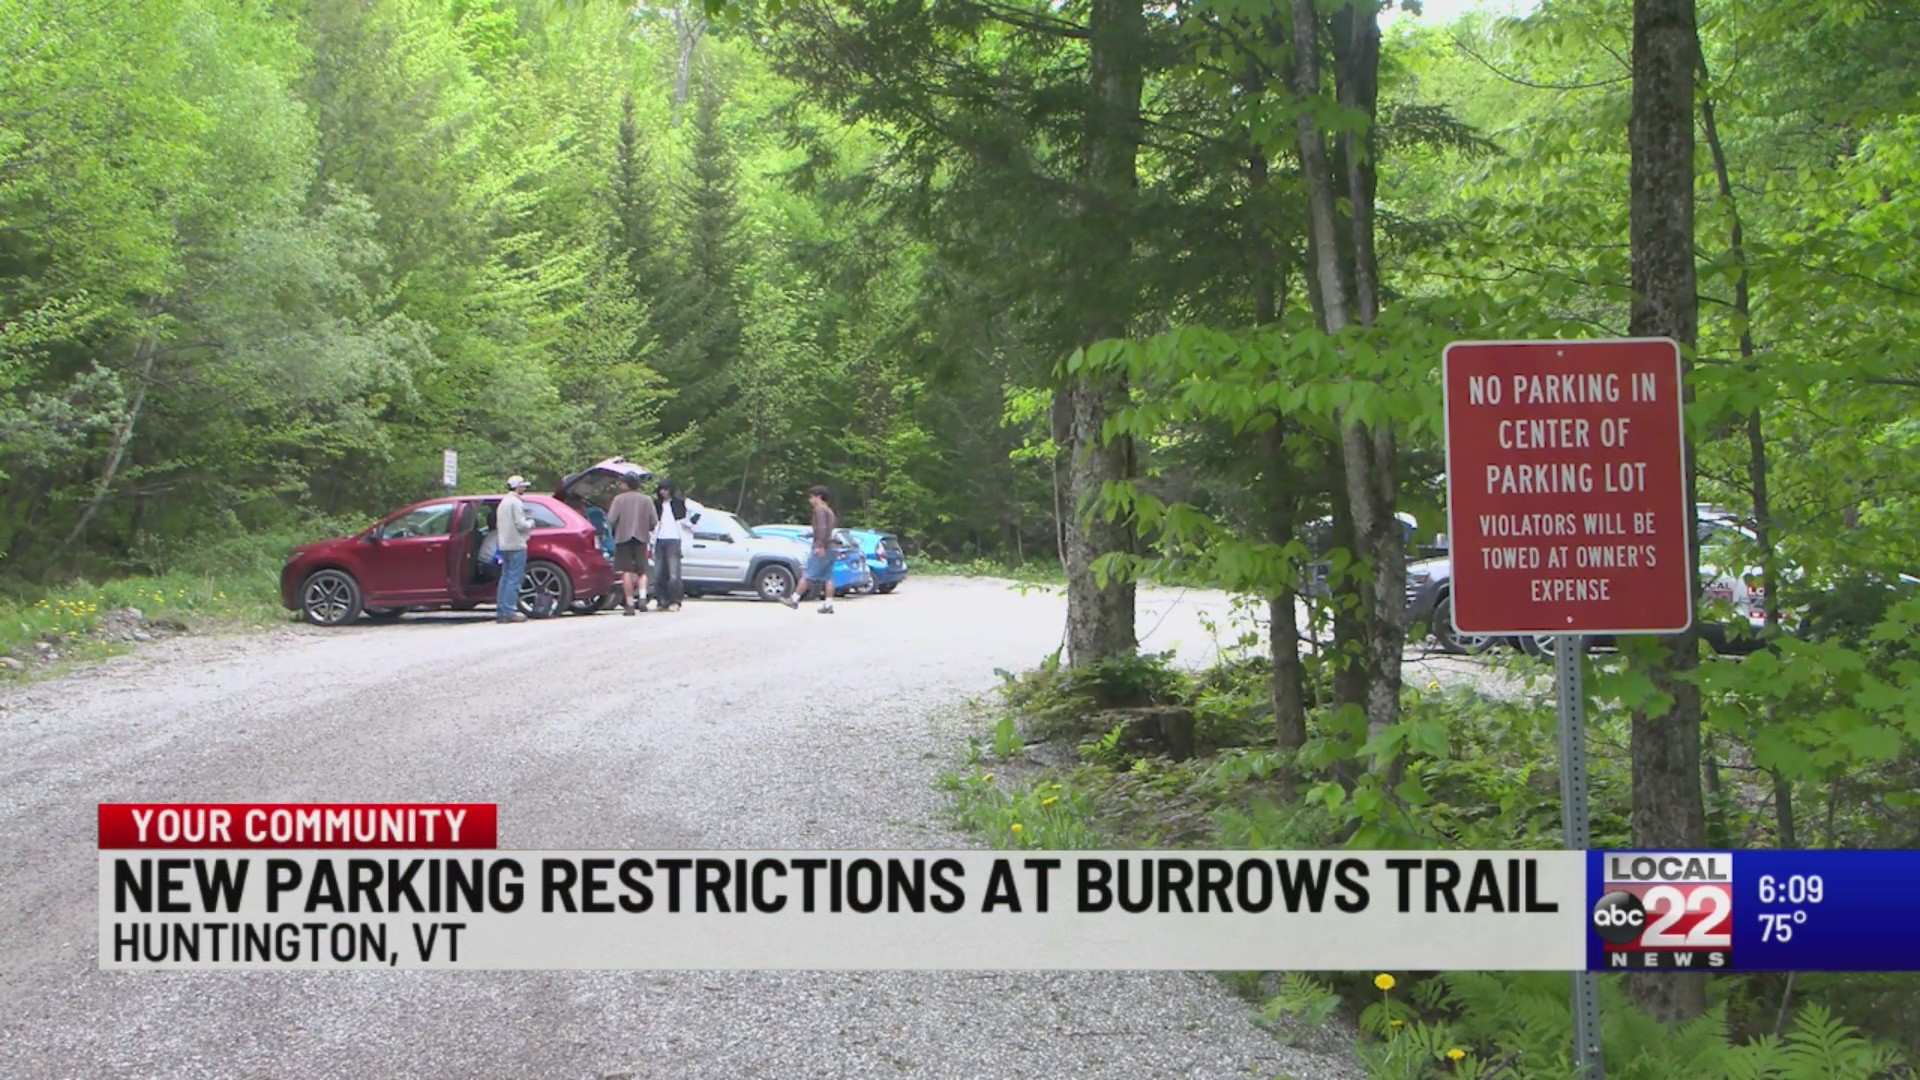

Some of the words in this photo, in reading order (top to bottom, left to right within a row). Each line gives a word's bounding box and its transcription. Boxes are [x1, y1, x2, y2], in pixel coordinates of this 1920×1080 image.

[1469, 375, 1501, 405] NO
[1513, 373, 1620, 404] PARKING
[1631, 373, 1656, 402] IN
[1499, 418, 1590, 449] CENTER
[1600, 418, 1631, 447] OF
[1486, 463, 1593, 494] PARKING
[1605, 462, 1647, 492] LOT
[1479, 514, 1577, 537] VIOLATORS
[1583, 513, 1626, 535] WILL
[1634, 512, 1656, 534] BE
[1481, 547, 1540, 569] TOWED
[1548, 546, 1568, 568] AT
[1576, 545, 1657, 568] OWNER'S
[1531, 579, 1611, 601] EXPENSE
